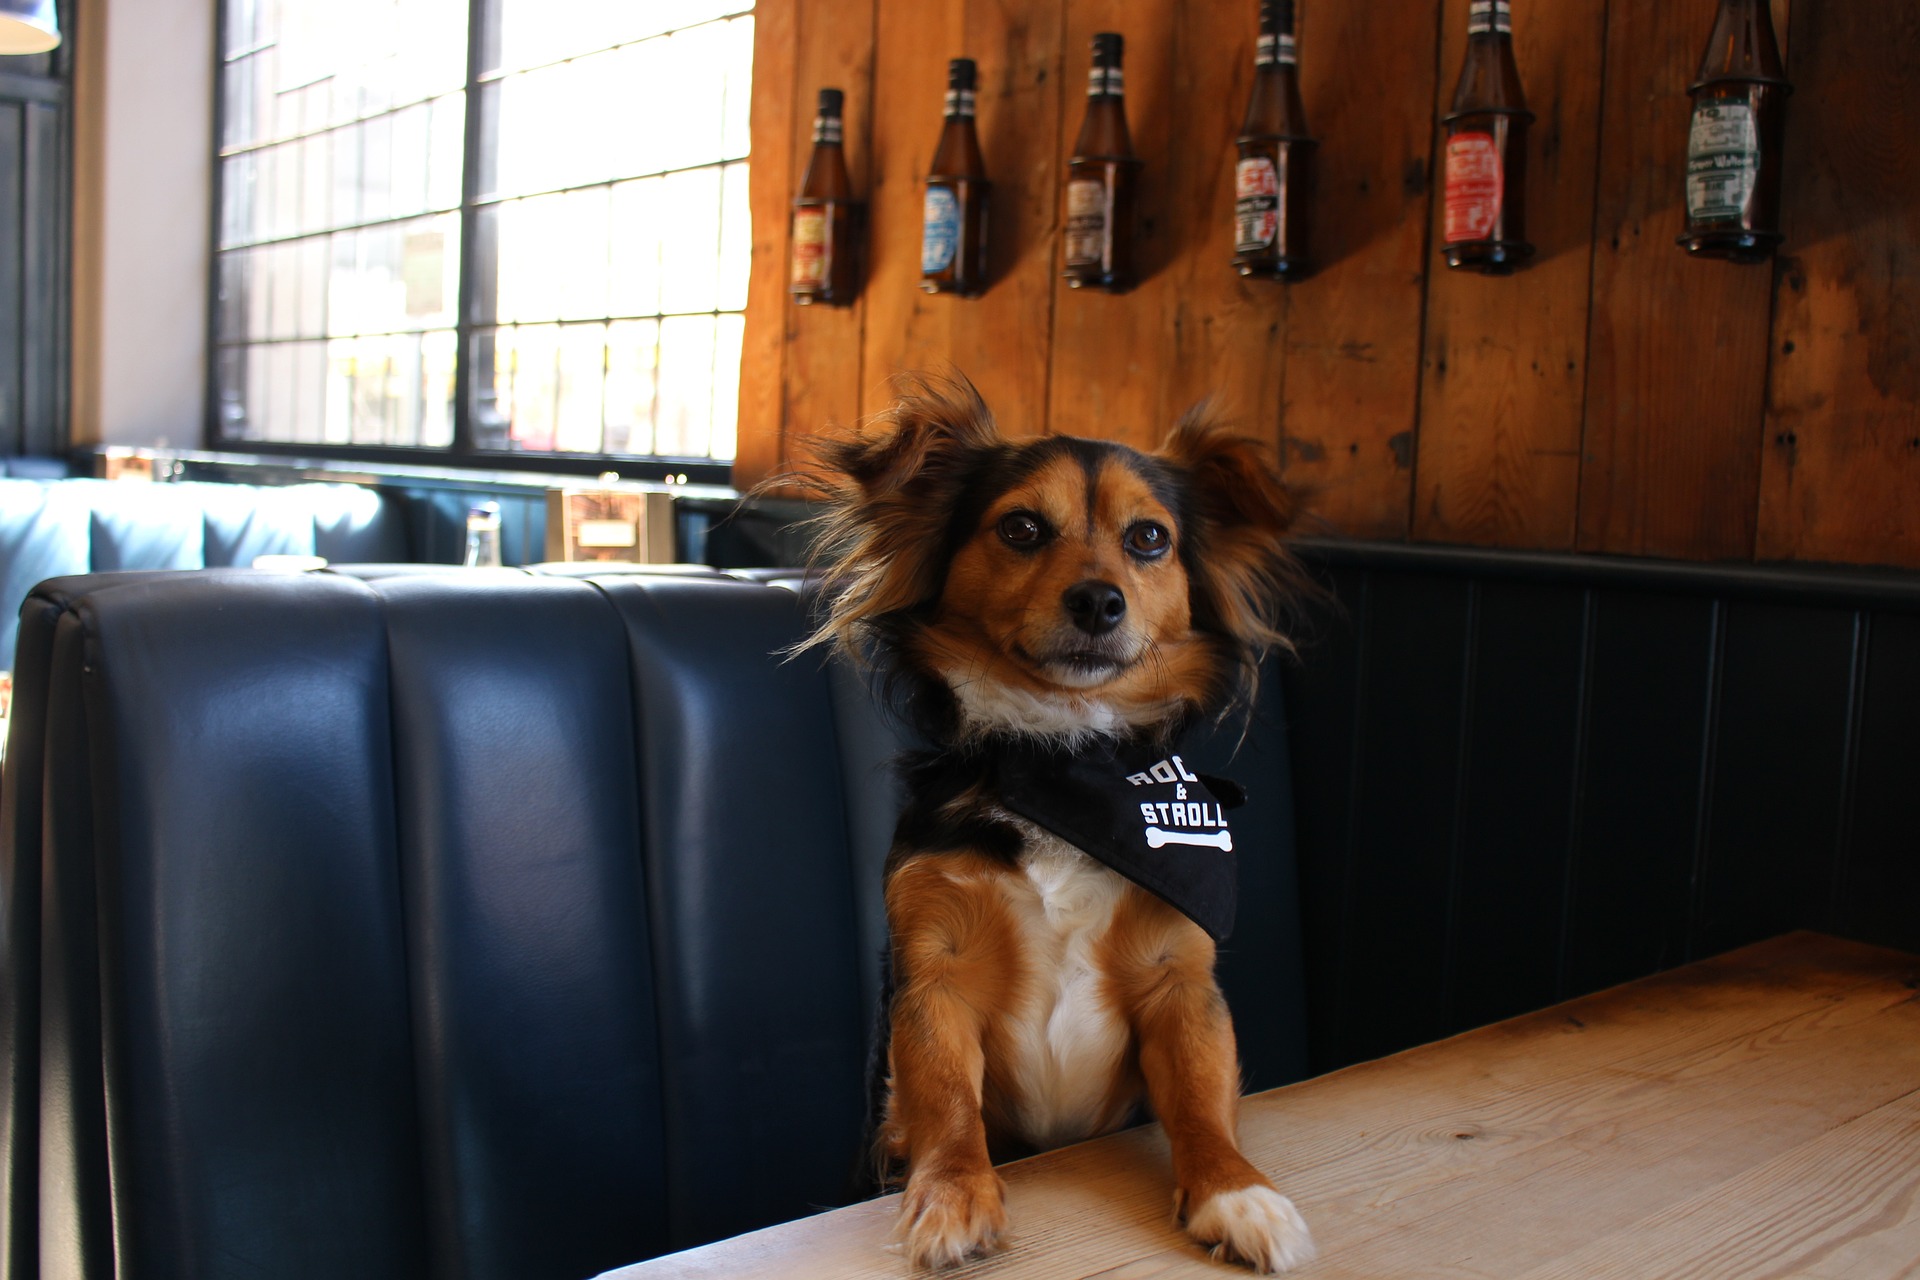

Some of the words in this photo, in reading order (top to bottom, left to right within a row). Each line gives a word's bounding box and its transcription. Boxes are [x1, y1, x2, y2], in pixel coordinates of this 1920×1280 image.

[1125, 755, 1198, 786] ROC
[1176, 783, 1187, 800] &
[1140, 803, 1228, 827] STROLL
